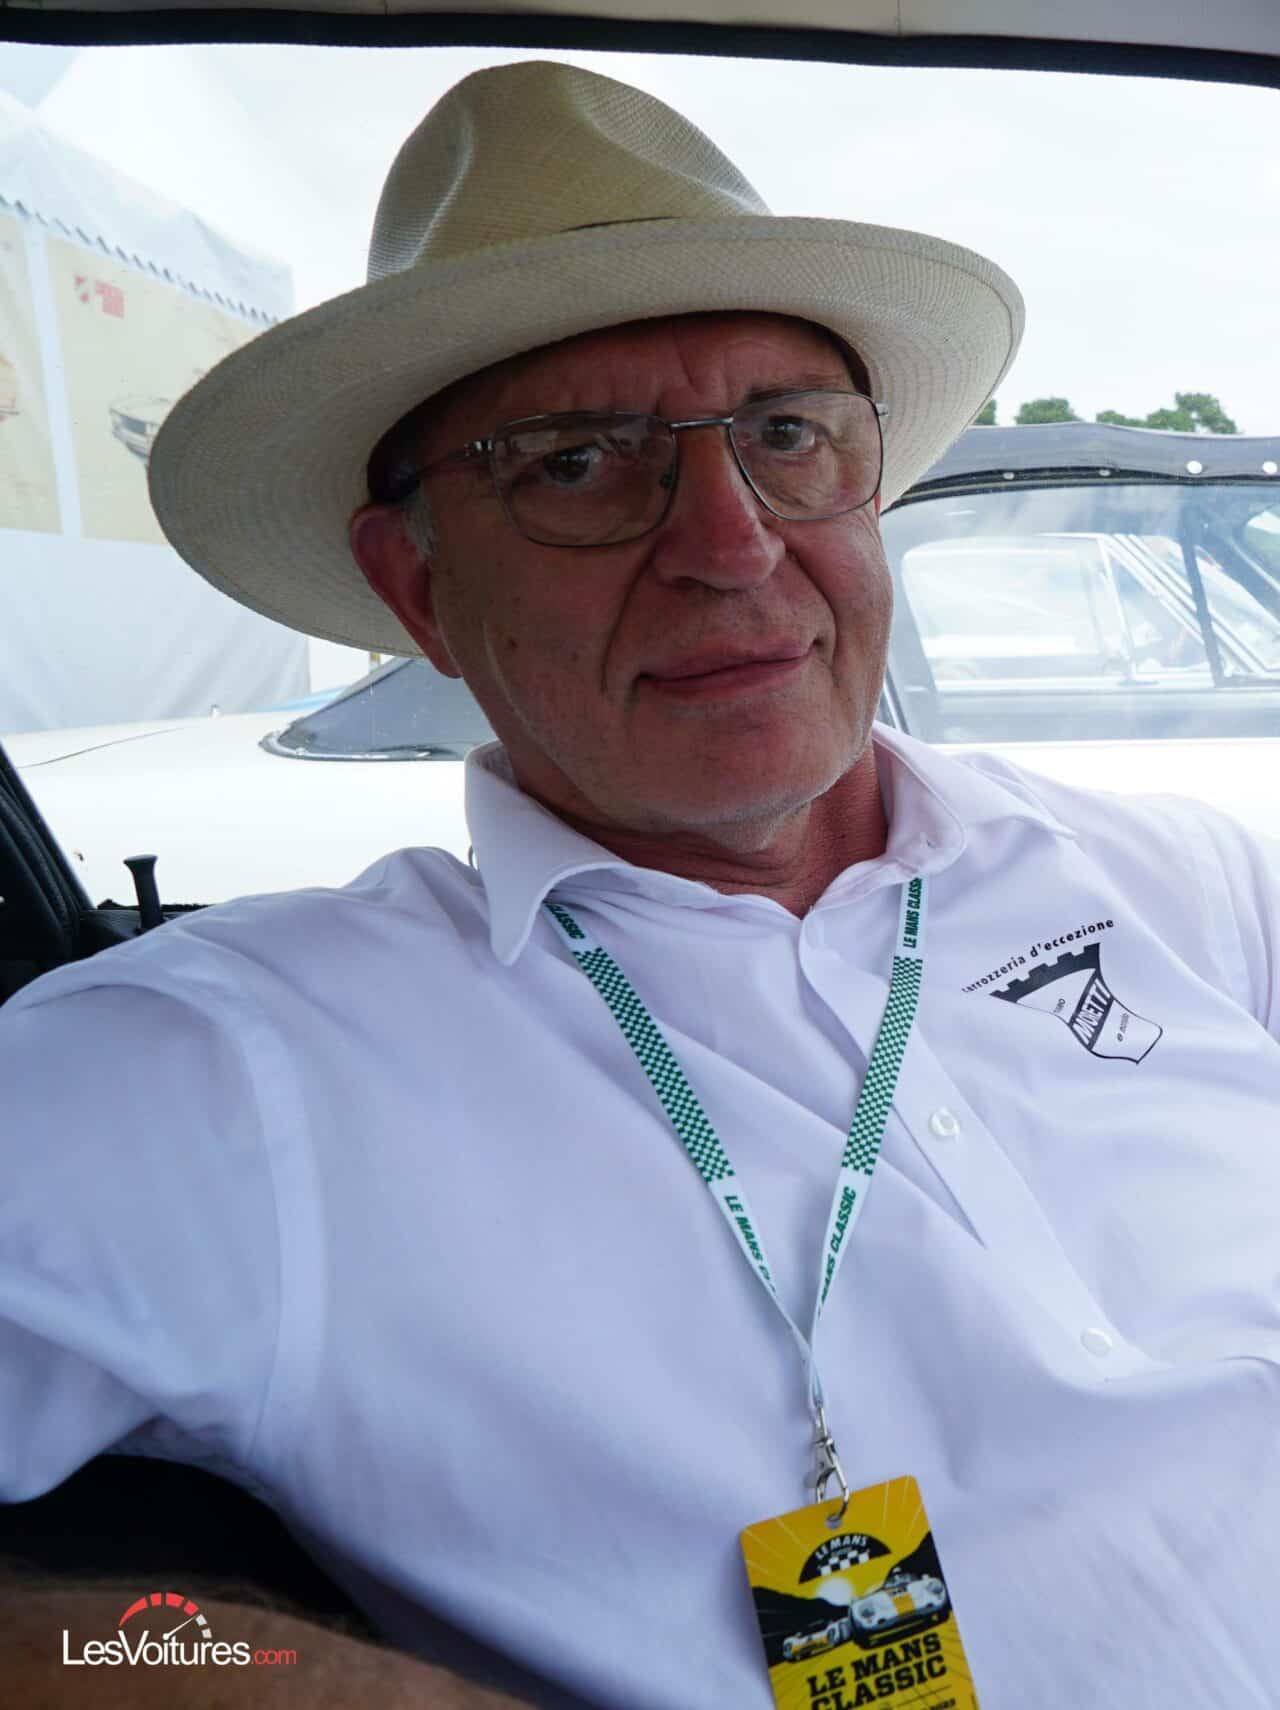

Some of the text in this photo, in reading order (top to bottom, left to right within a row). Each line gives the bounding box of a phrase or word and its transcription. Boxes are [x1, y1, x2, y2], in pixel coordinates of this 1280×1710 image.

[903, 877, 923, 949] LE MANS CLASS
[1029, 919, 1115, 958] d'eccezione
[723, 1194, 764, 1262] LE MANS
[829, 1185, 857, 1254] CLASSIC
[829, 1535, 868, 1550] MANS
[807, 1632, 942, 1698] LE MANS
[811, 1653, 947, 1710] CLASSIC
